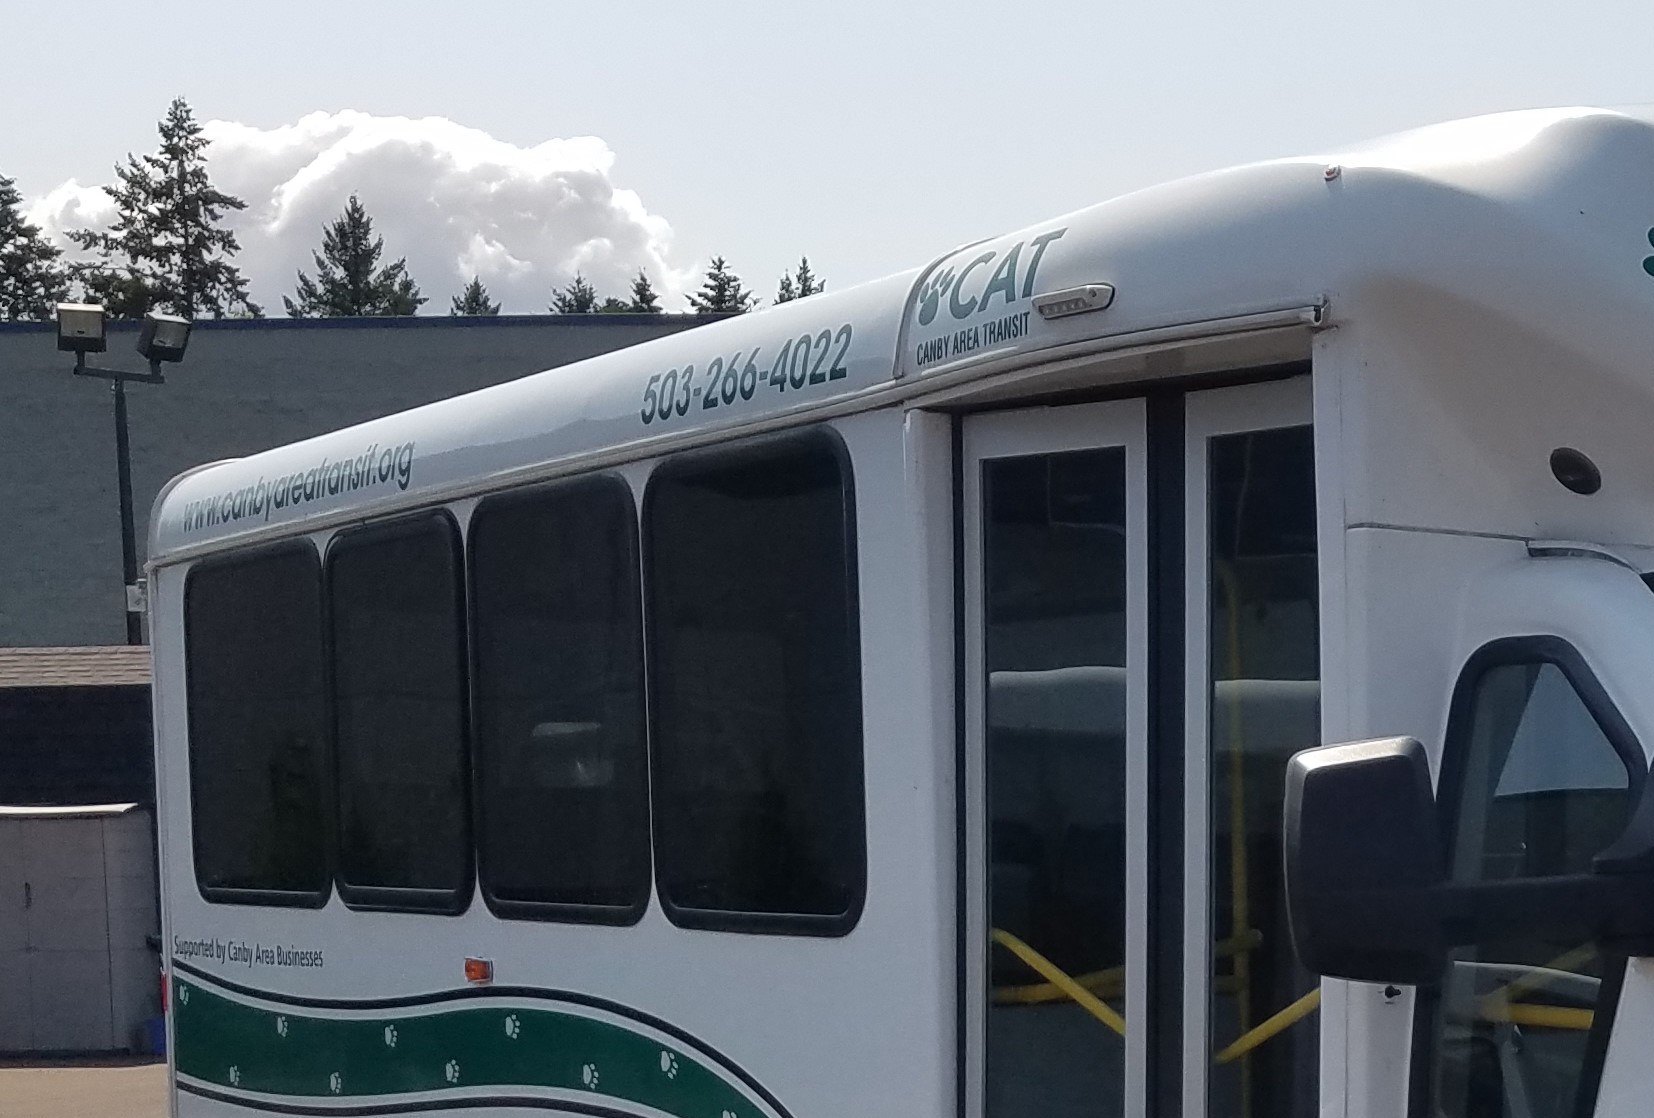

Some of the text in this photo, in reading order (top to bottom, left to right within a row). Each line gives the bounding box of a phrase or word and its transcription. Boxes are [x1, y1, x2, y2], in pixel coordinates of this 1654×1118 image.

[949, 227, 1067, 320] CAT
[640, 323, 853, 425] 503-266-4022
[916, 311, 1031, 366] CANBY AREA TRANSIT
[183, 441, 415, 533] www.canbyareatransit.org
[174, 935, 324, 968] Supported by Canby Area Businesses
